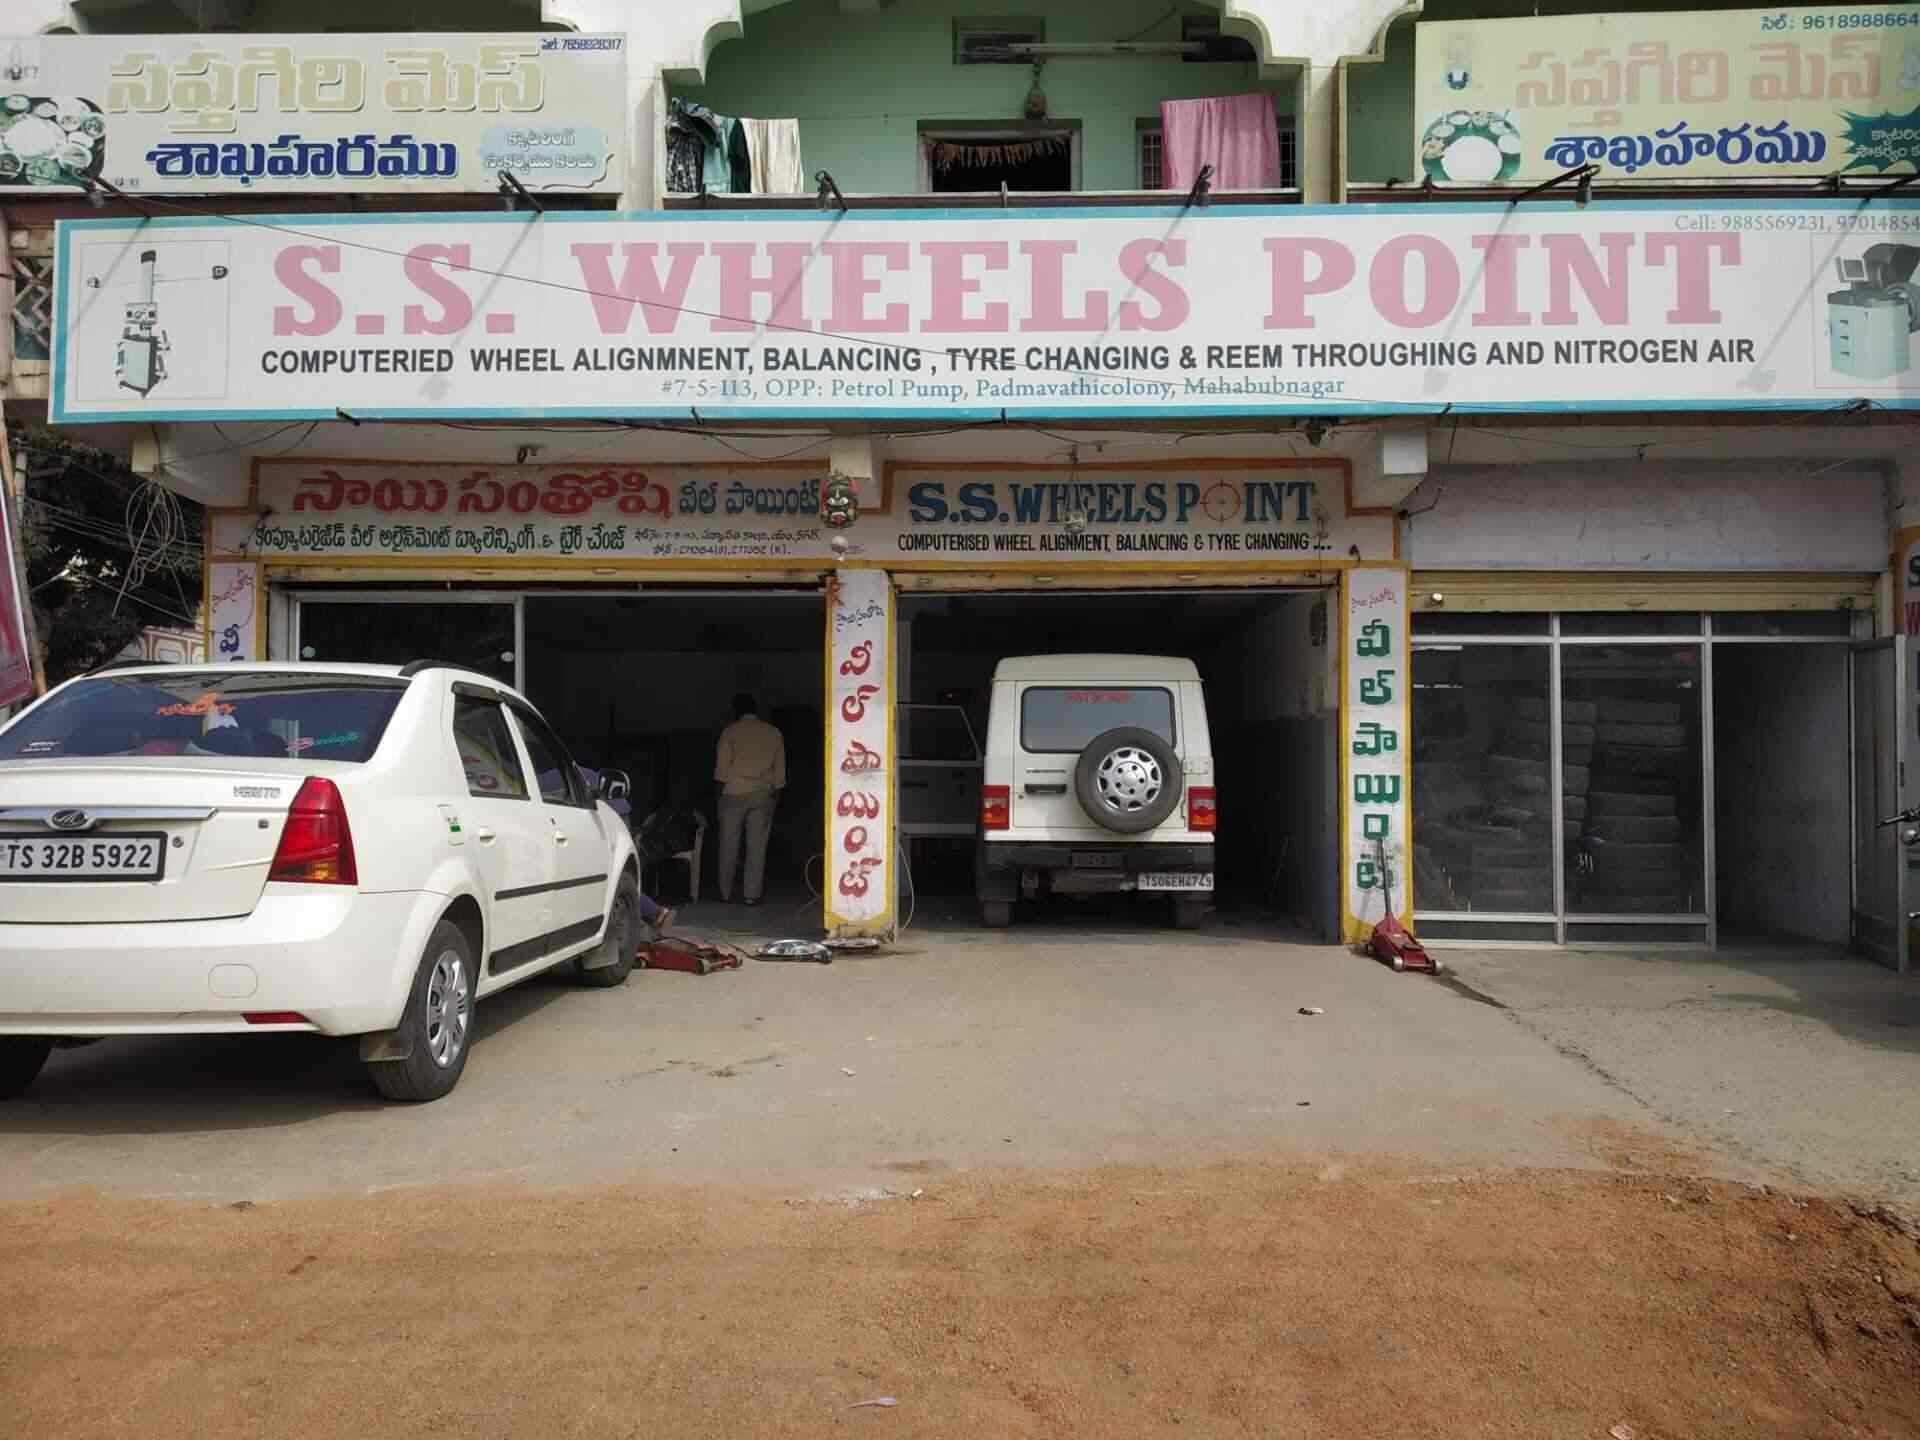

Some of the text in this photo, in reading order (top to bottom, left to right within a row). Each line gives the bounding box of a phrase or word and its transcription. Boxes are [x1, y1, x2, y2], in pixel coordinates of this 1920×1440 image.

[1802, 12, 1919, 30] 9618988664
[110, 46, 545, 133] సప్తగిరి మెస్
[1515, 32, 1881, 127] సప్తగిరి మెస్
[145, 134, 459, 185] శాఖహారము
[1544, 120, 1827, 173] శాఖహారము
[1675, 214, 1716, 231] Cell:
[273, 232, 1743, 337] S.S. WHEELS POINT
[261, 349, 454, 374] COMPUTERIED
[470, 348, 564, 372] WHEEL
[764, 347, 921, 371] BALANCING
[946, 347, 1016, 371] TYRE
[1025, 346, 1169, 371] CHANGING
[1179, 345, 1197, 369] &
[1207, 344, 1282, 369] REEM
[1292, 342, 1477, 368] THROUGHING
[1486, 341, 1545, 365] AND
[1554, 339, 1697, 364] NITROGEN
[1707, 339, 1755, 363] AIR
[766, 379, 823, 398] OPP:
[831, 378, 896, 397] Petrol
[902, 379, 968, 401] Pump,
[1184, 376, 1345, 398] Mahabubnagar
[293, 470, 449, 513] సాయి
[456, 470, 673, 519] సంతోషి
[679, 480, 719, 514] వీల్
[898, 533, 989, 551] COMPUTERISED
[993, 534, 1036, 551] WHEEL
[1116, 533, 1188, 551] BALANCING
[1194, 533, 1204, 550] &
[1207, 533, 1240, 550] TYRE
[7, 844, 153, 869] TS 32B 5922
